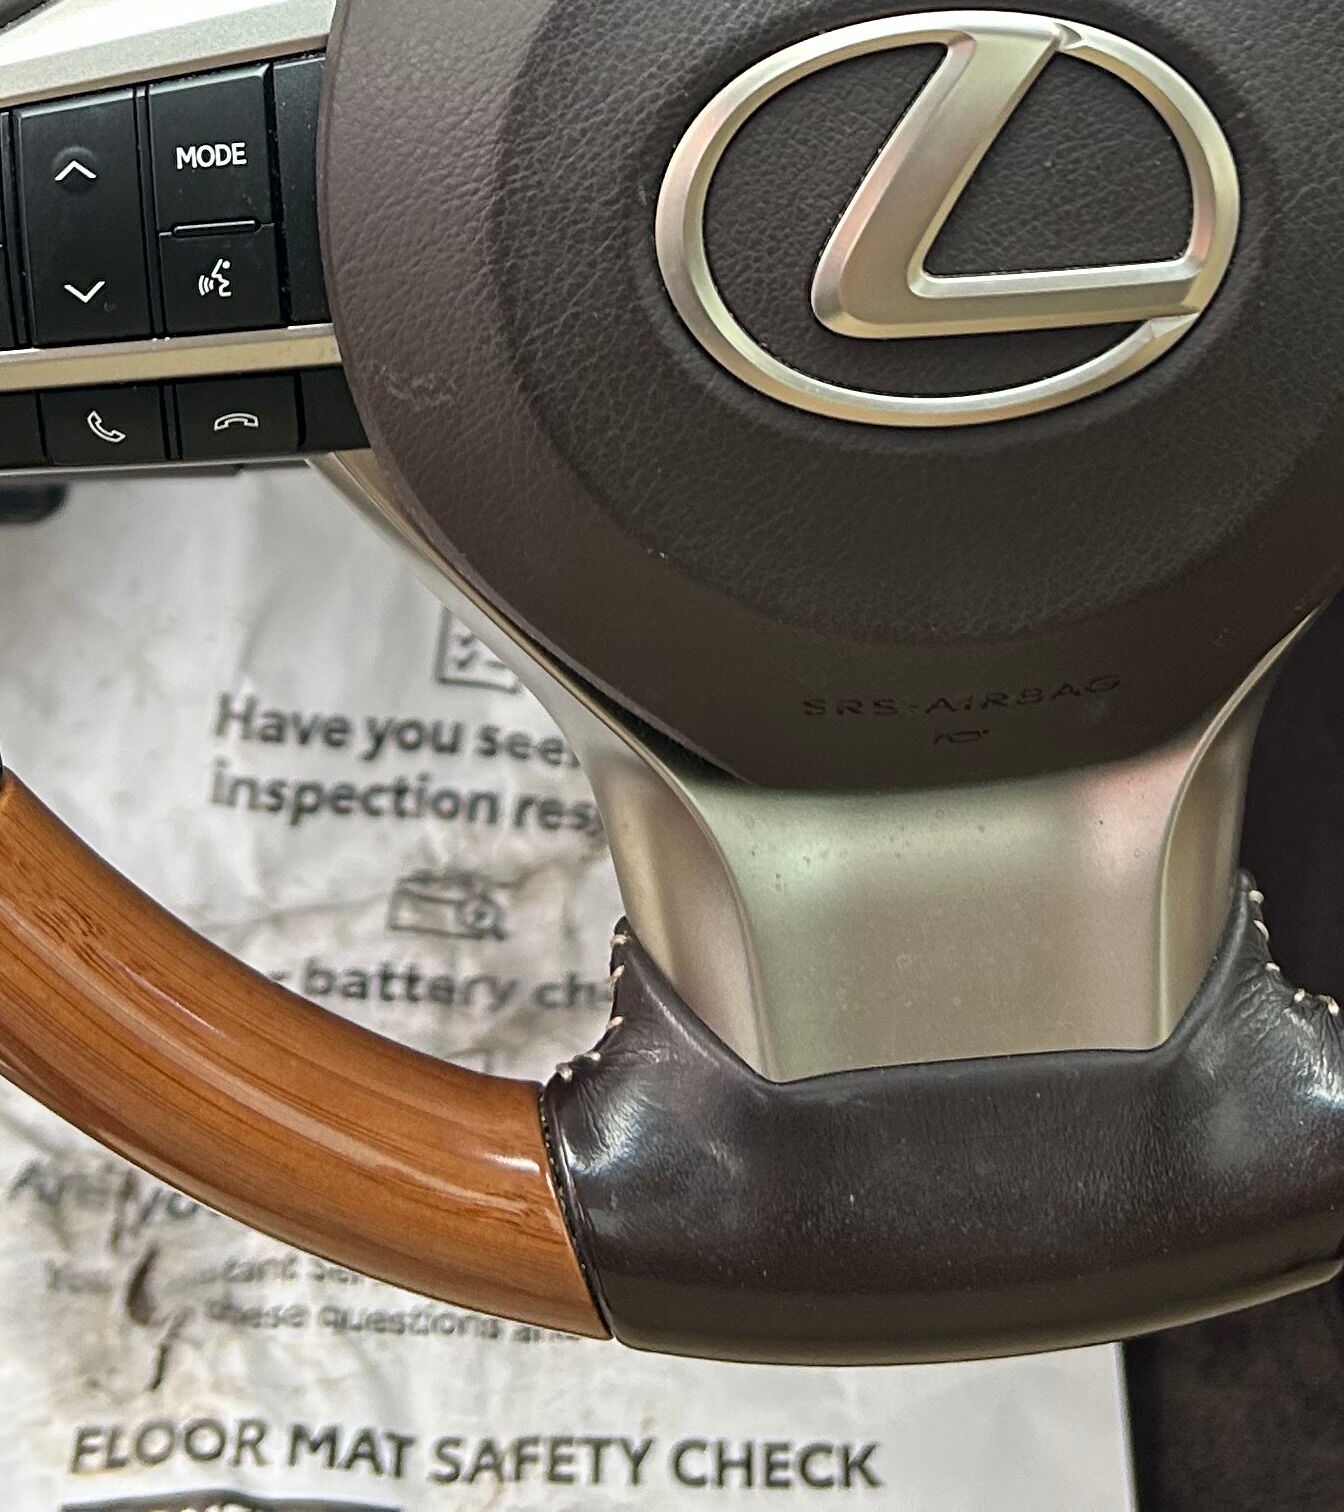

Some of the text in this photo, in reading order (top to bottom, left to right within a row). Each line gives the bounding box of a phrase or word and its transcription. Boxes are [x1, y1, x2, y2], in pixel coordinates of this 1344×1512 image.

[175, 142, 248, 170] MODE
[214, 691, 580, 769] Have you see
[209, 756, 499, 829] inspection
[303, 956, 518, 1012] battery
[68, 1416, 884, 1492] FLOOR MAT SAFETY CHECK
